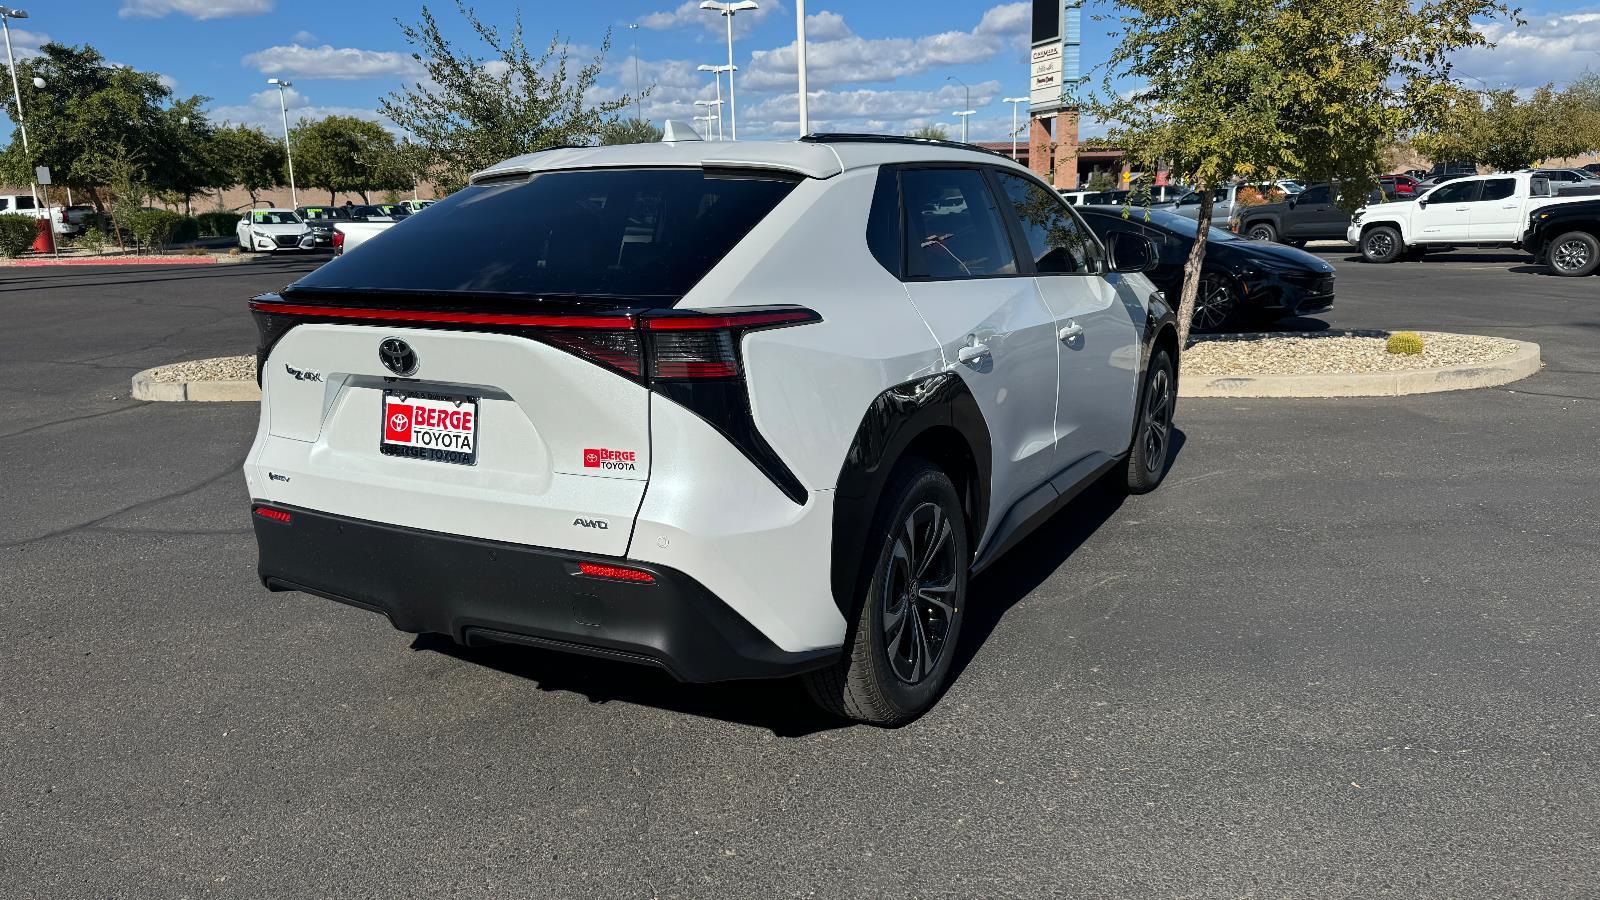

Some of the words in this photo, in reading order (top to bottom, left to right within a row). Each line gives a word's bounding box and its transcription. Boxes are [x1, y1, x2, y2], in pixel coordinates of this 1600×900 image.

[415, 406, 473, 431] BERGE
[414, 430, 472, 450] TOYOTA
[430, 449, 470, 463] TOYOTA
[601, 448, 636, 461] BERGE
[601, 461, 636, 471] TOYOTA
[572, 518, 609, 529] AWD
